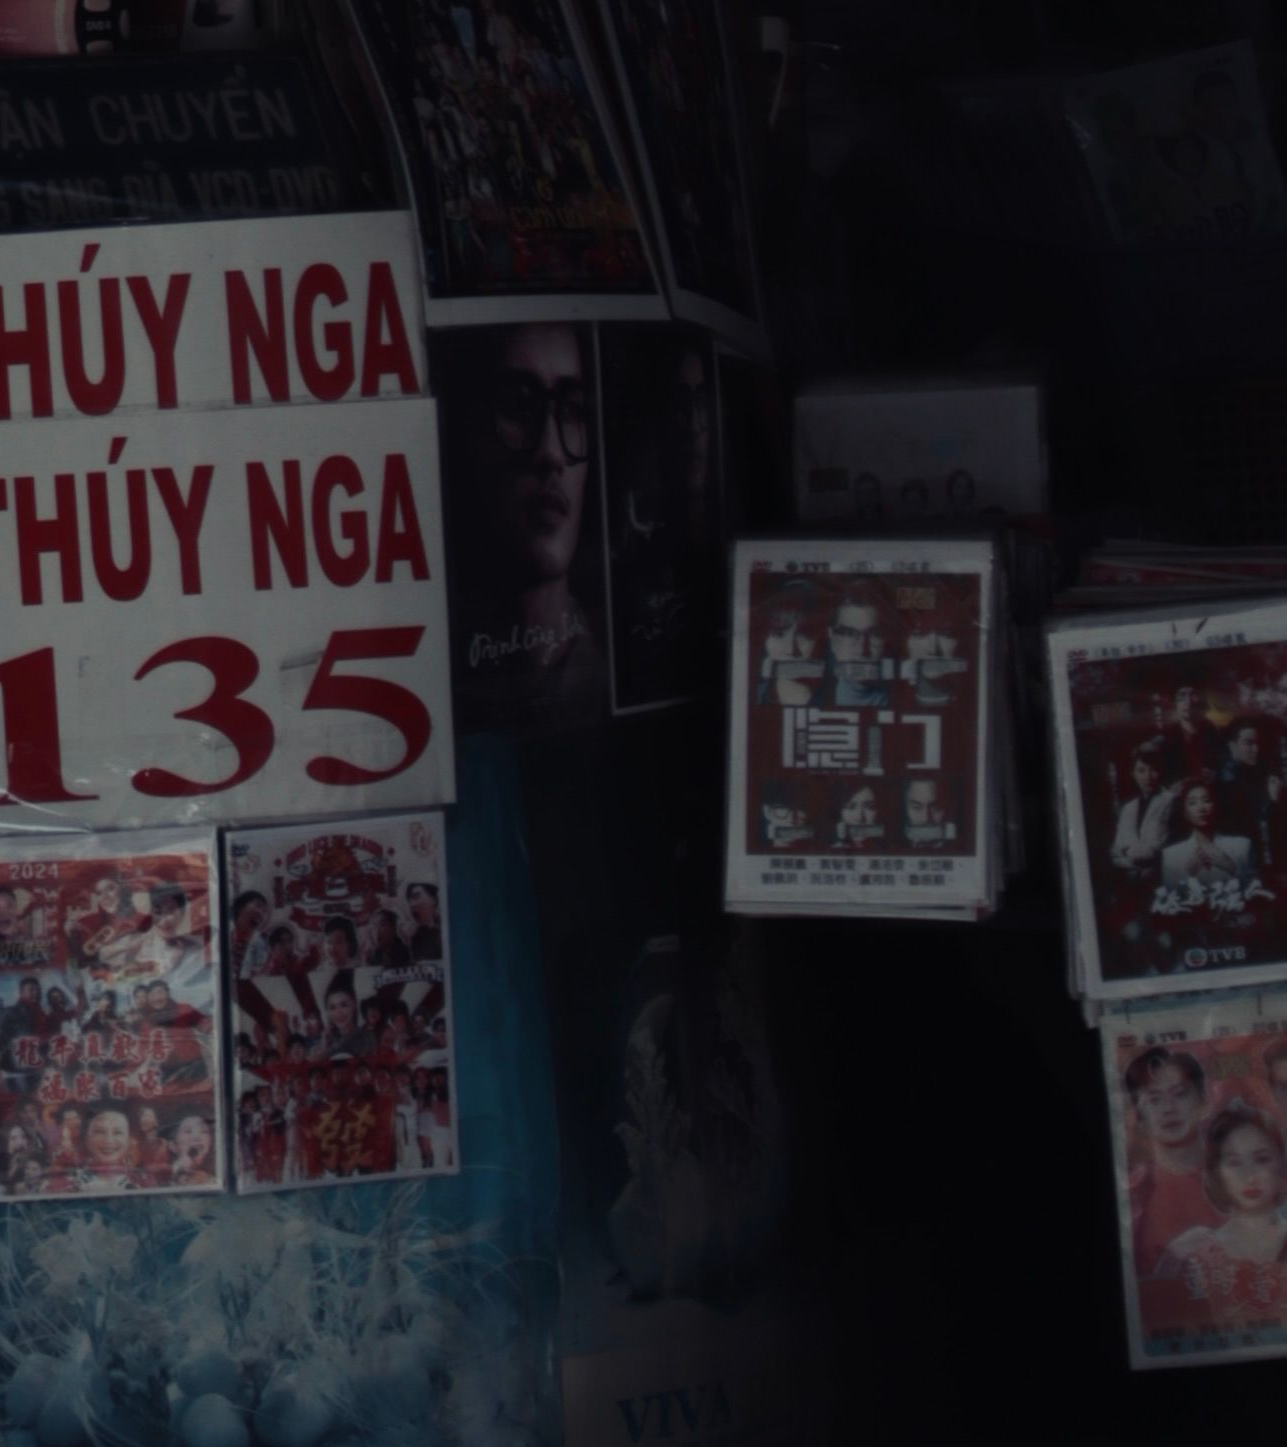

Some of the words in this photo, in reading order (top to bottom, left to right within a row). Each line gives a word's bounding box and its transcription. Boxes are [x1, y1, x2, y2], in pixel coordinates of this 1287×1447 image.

[87, 64, 298, 146] CHUYỂN
[224, 260, 420, 406] NGA
[242, 453, 432, 593] NGA
[9, 863, 61, 881] 2024
[1208, 945, 1248, 962] TVB
[616, 1380, 734, 1444] VIVA
